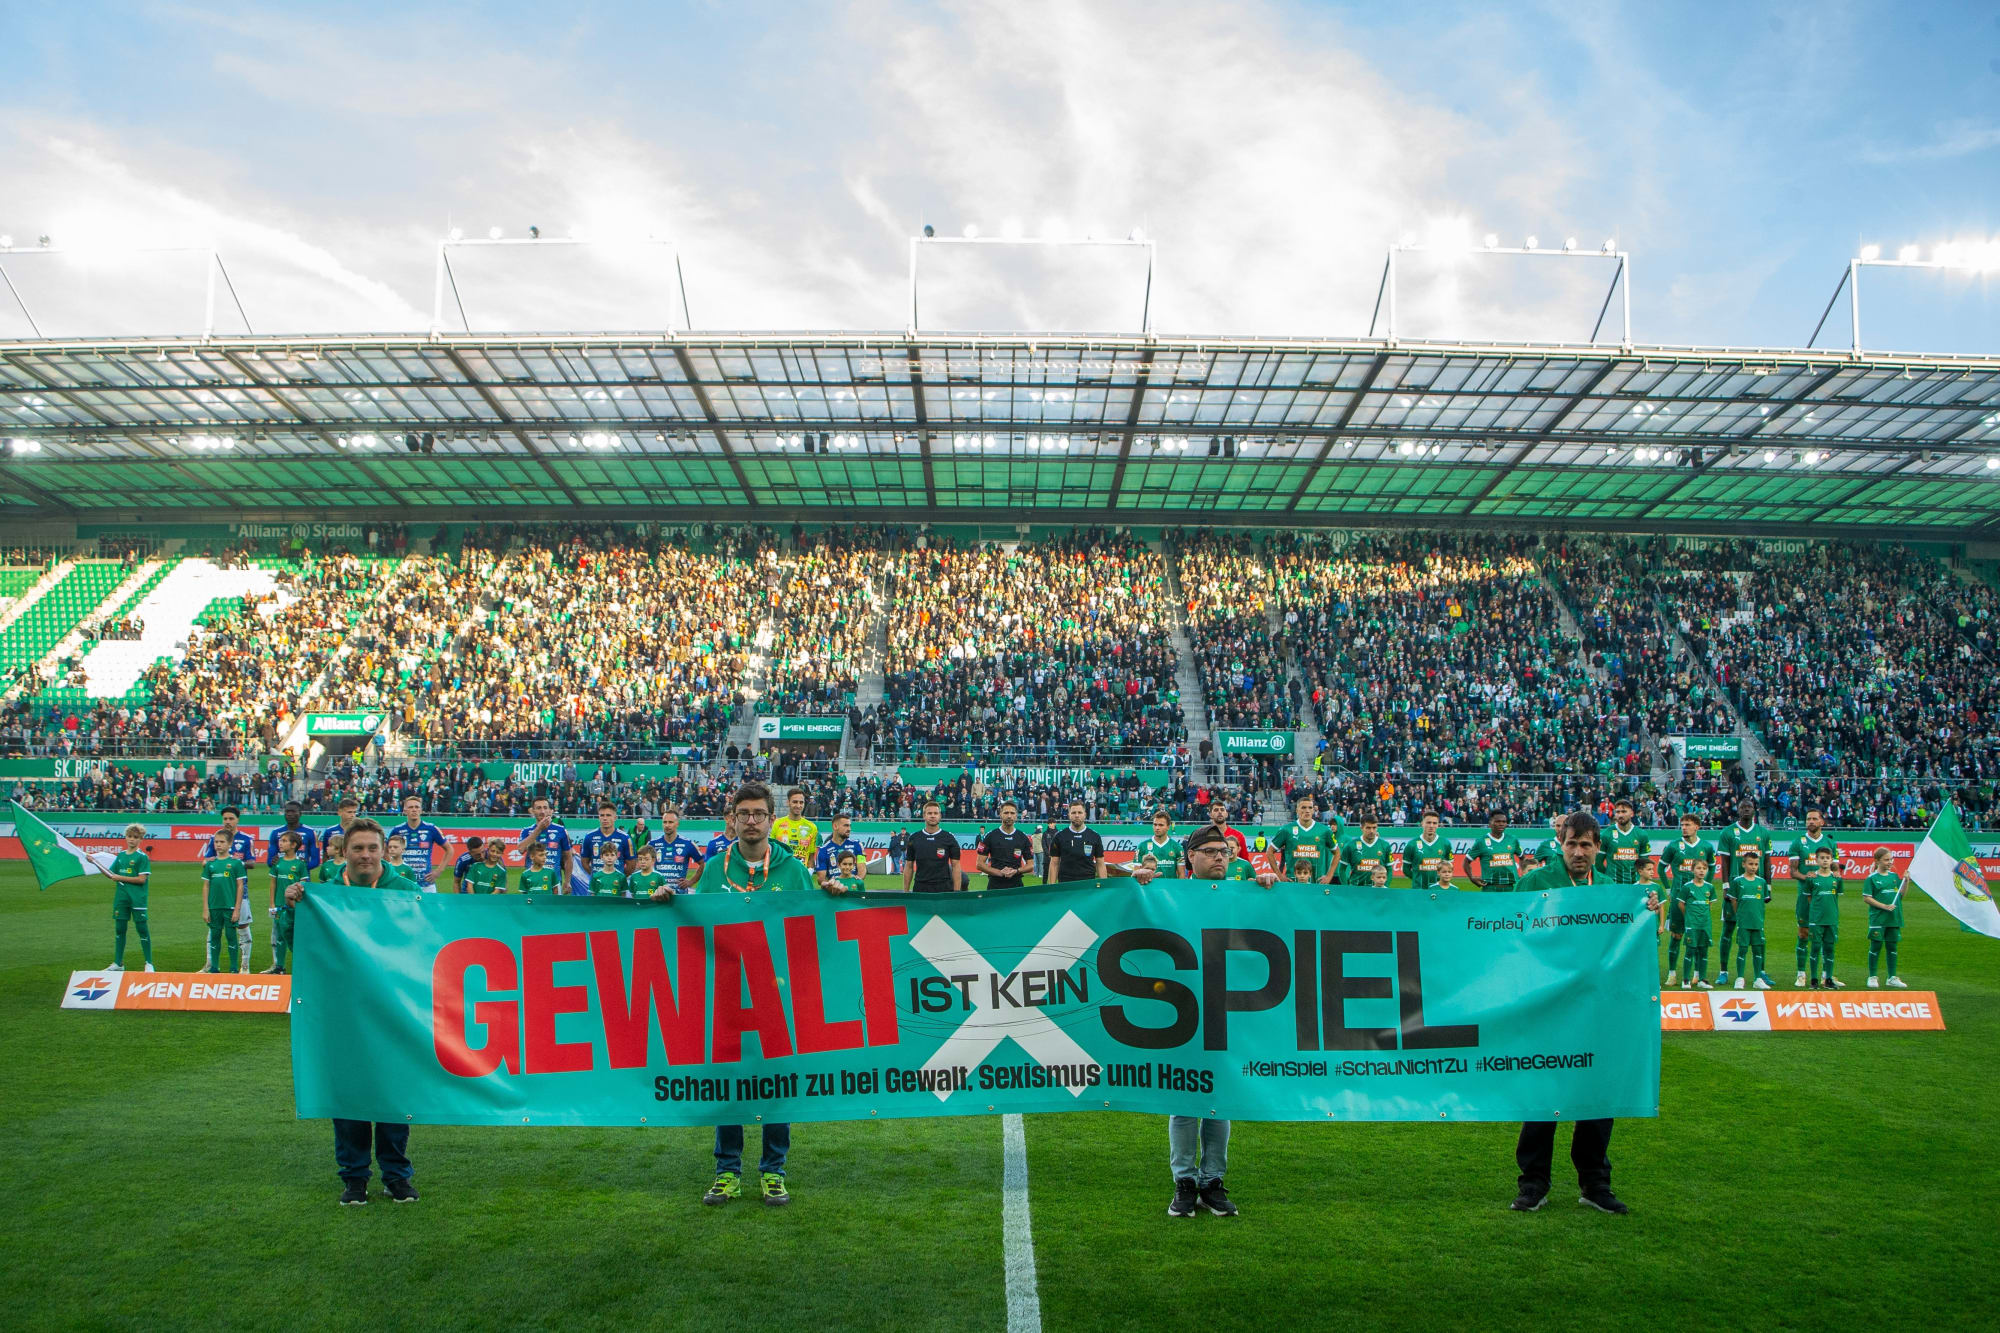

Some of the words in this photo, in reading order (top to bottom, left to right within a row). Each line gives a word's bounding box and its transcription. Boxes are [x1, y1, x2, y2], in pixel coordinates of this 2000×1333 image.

[239, 524, 288, 538] Allianz
[312, 717, 361, 731] Allianz
[1227, 737, 1268, 748] Allianz
[1709, 744, 1738, 752] ENERGIE
[55, 760, 70, 777] SK
[1467, 916, 1524, 932] fairplay
[1532, 912, 1634, 929] AKTIONSWOCHEN
[127, 982, 184, 999] WIEN
[189, 983, 282, 1001] ENERGIE
[432, 906, 909, 1078] GEWALT
[910, 974, 979, 1014] IST
[990, 967, 1089, 1010] KEIN
[1096, 928, 1479, 1052] SPIEL
[1660, 1002, 1702, 1019] RGIE
[1776, 1002, 1834, 1018] WIEN
[1839, 1002, 1932, 1019] ENERGIE
[1241, 1060, 1328, 1077] #KeinSpiel
[1334, 1057, 1468, 1077] #SchauNichtZu
[1475, 1052, 1595, 1073] #KeineGewalt
[654, 1075, 730, 1101] Schau
[737, 1072, 798, 1100] nicht
[805, 1072, 835, 1097] zu
[841, 1067, 879, 1095] bei
[978, 1062, 1101, 1091] Sexismus
[1107, 1062, 1152, 1089] und
[1157, 1063, 1215, 1093] Hass
